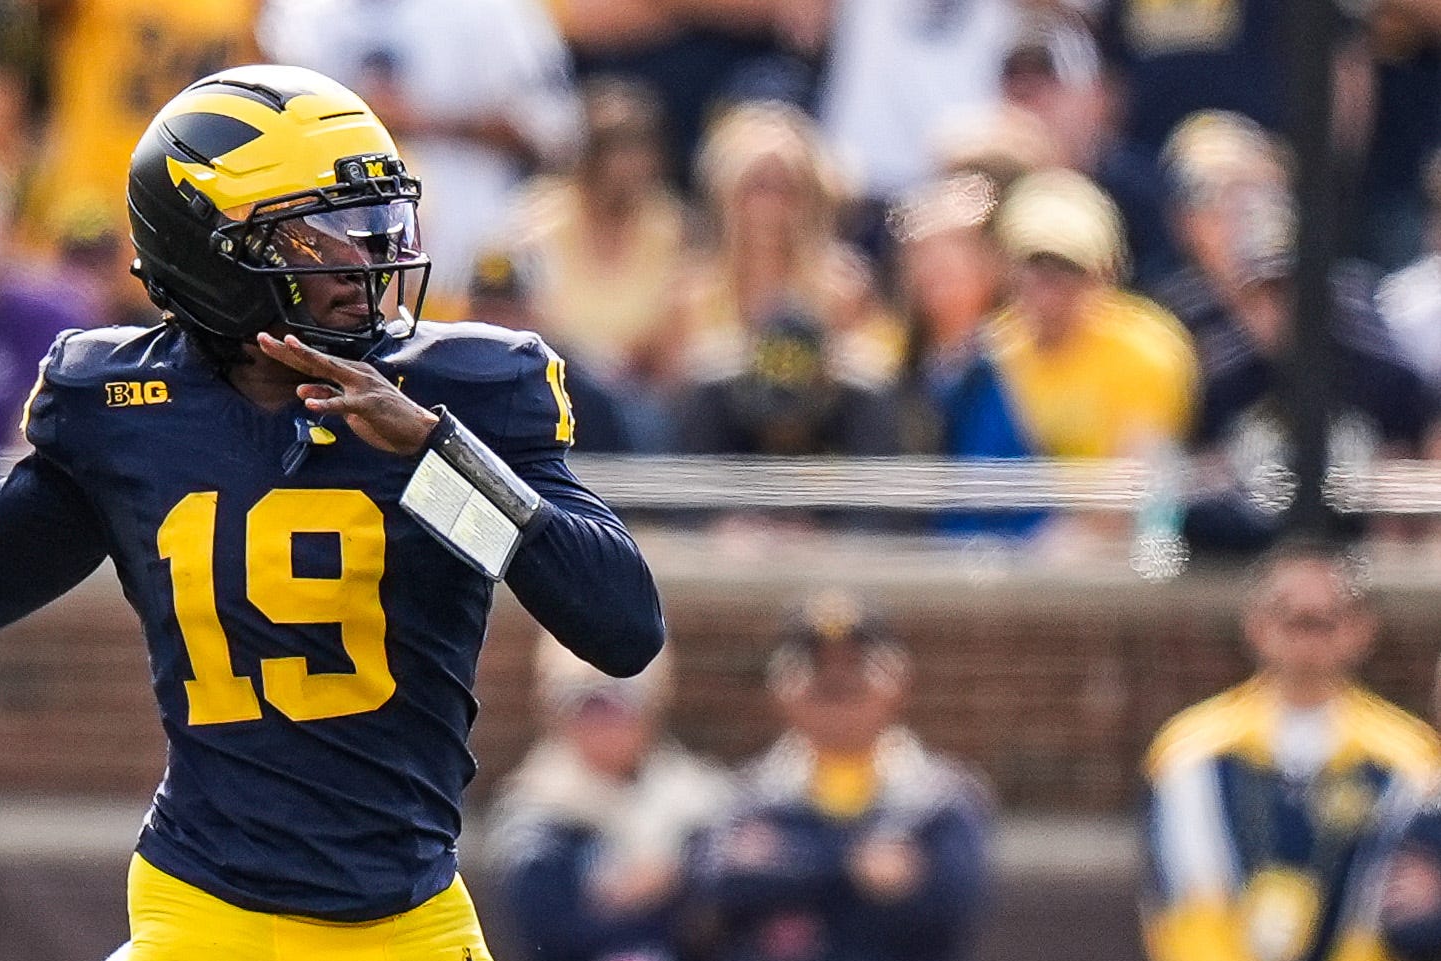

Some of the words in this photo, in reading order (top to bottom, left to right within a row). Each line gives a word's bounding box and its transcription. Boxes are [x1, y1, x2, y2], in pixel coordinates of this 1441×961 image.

[365, 162, 385, 177] M
[545, 358, 575, 448] 1
[156, 487, 397, 727] 19
